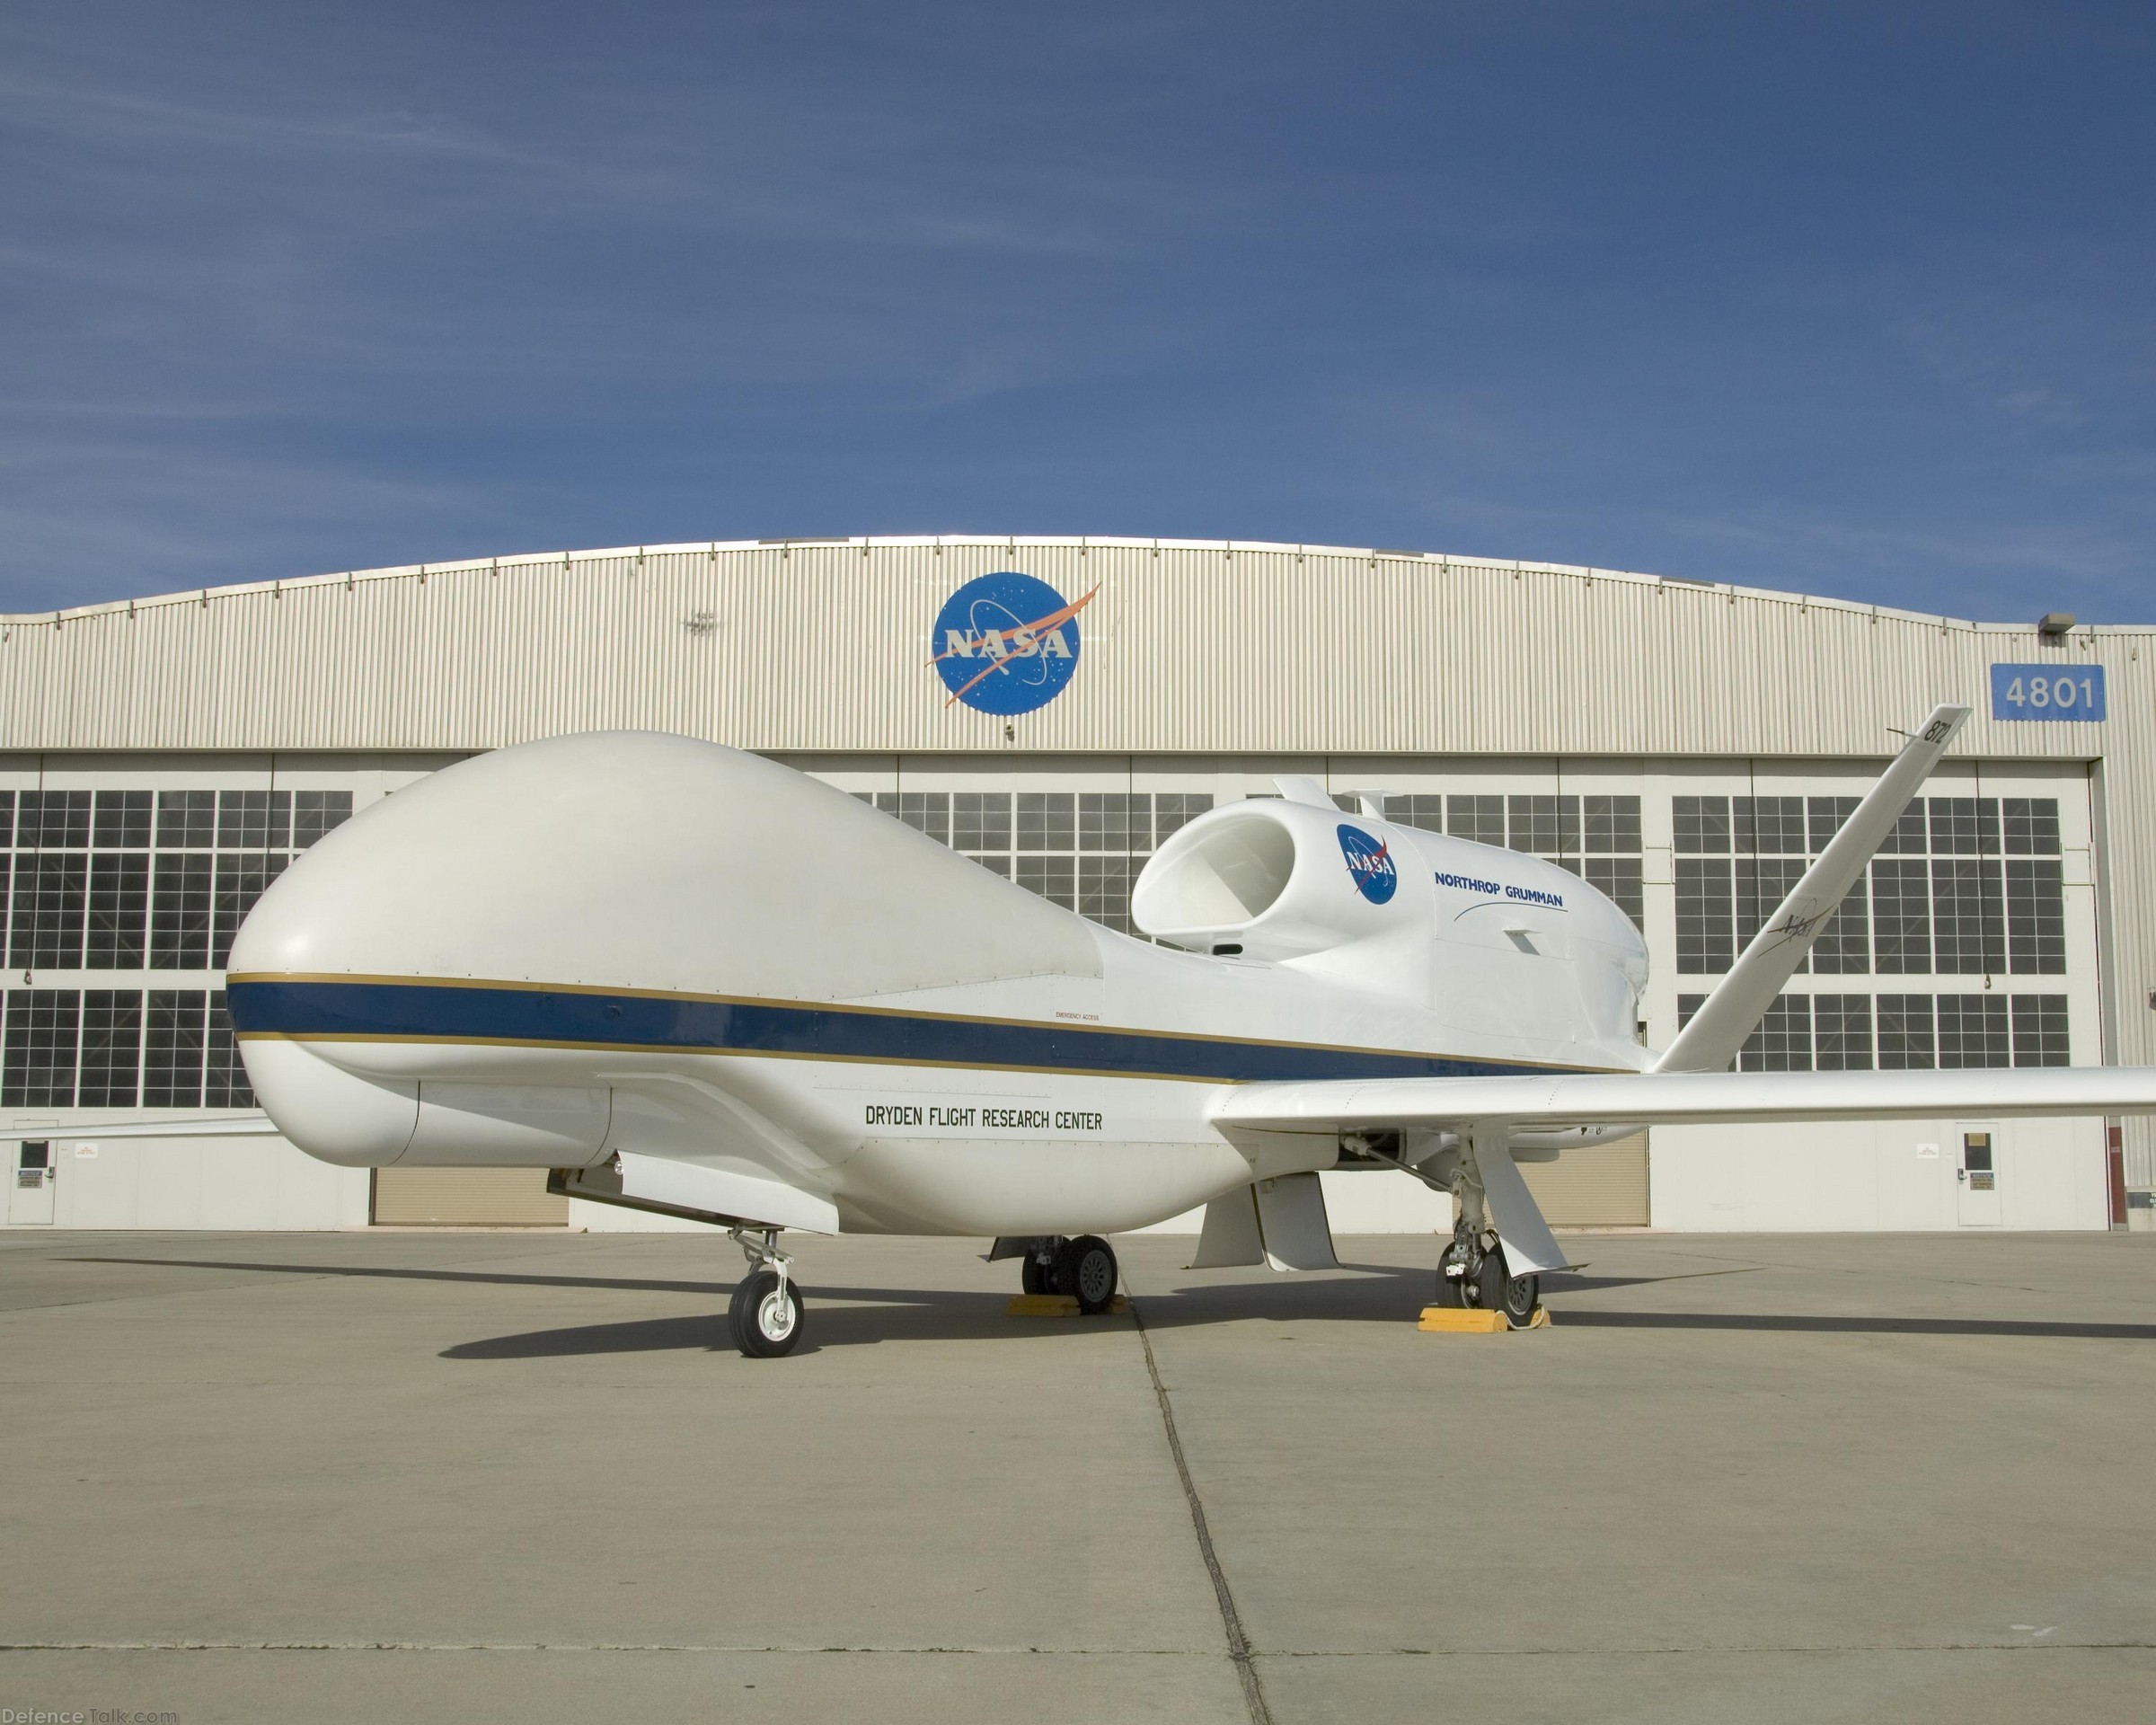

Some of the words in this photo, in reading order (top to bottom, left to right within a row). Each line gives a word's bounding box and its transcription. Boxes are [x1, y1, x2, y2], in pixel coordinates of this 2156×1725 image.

[945, 629, 1073, 659] NASA
[2006, 677, 2092, 708] 4801
[1924, 720, 1952, 745] 872
[1347, 851, 1394, 875] NASA
[1435, 871, 1500, 895] NORTHROP
[1505, 885, 1563, 907] GRUMMAN
[1056, 1011, 1082, 1020] EMERGENCY
[866, 1105, 922, 1125] DRYDEN
[929, 1107, 976, 1127] FLIGHT
[982, 1109, 1049, 1128] RESEARCH
[1055, 1111, 1102, 1130] CENTER
